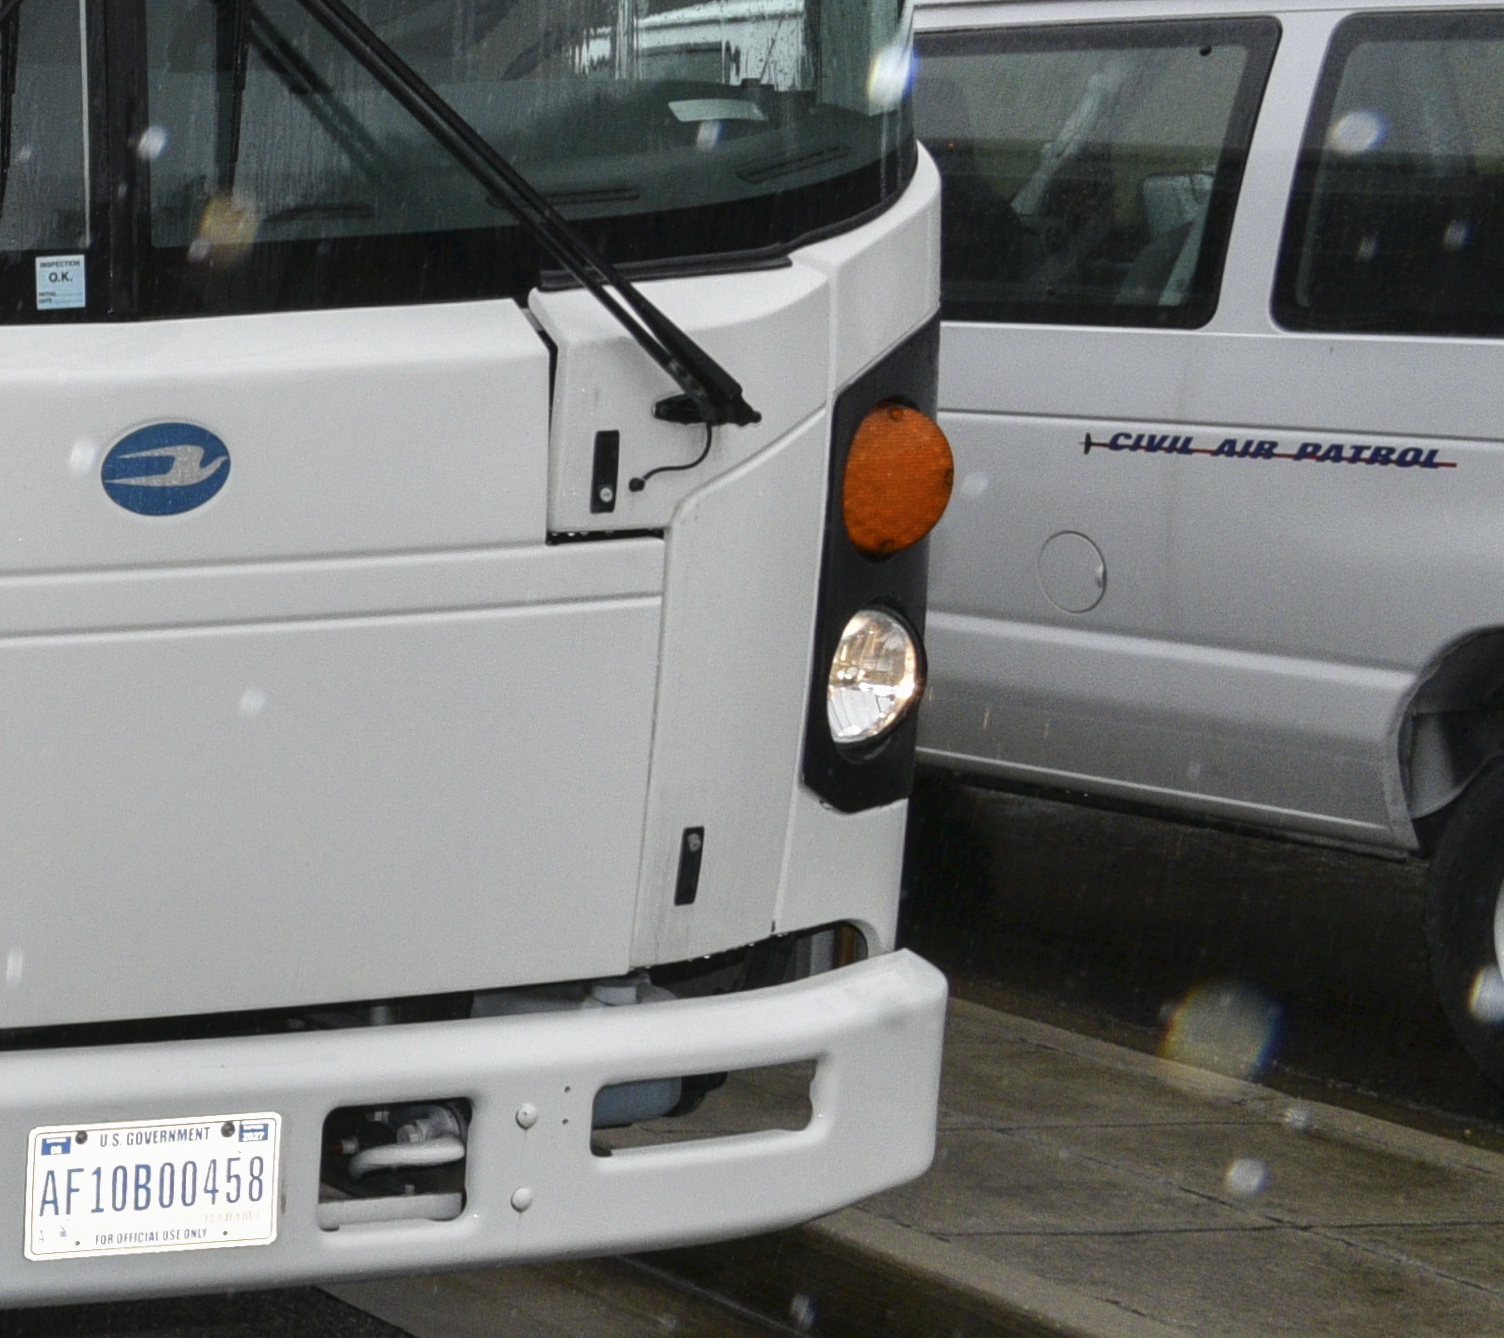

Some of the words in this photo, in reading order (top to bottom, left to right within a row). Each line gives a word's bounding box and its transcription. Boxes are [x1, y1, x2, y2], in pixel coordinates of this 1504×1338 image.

[39, 260, 80, 268] INSPECTION
[48, 271, 73, 283] O.K.
[1107, 432, 1194, 456] CIVIL
[1211, 438, 1280, 460] AIR
[1291, 442, 1440, 469] PATROL
[100, 1133, 122, 1148] U.S.
[126, 1127, 210, 1146] GOVERNMENT
[39, 1156, 264, 1217] AF10B00458
[95, 1234, 114, 1246] FOR
[116, 1231, 160, 1244] OFFICIAL
[162, 1229, 180, 1241] USE
[183, 1228, 207, 1239] ONLY
